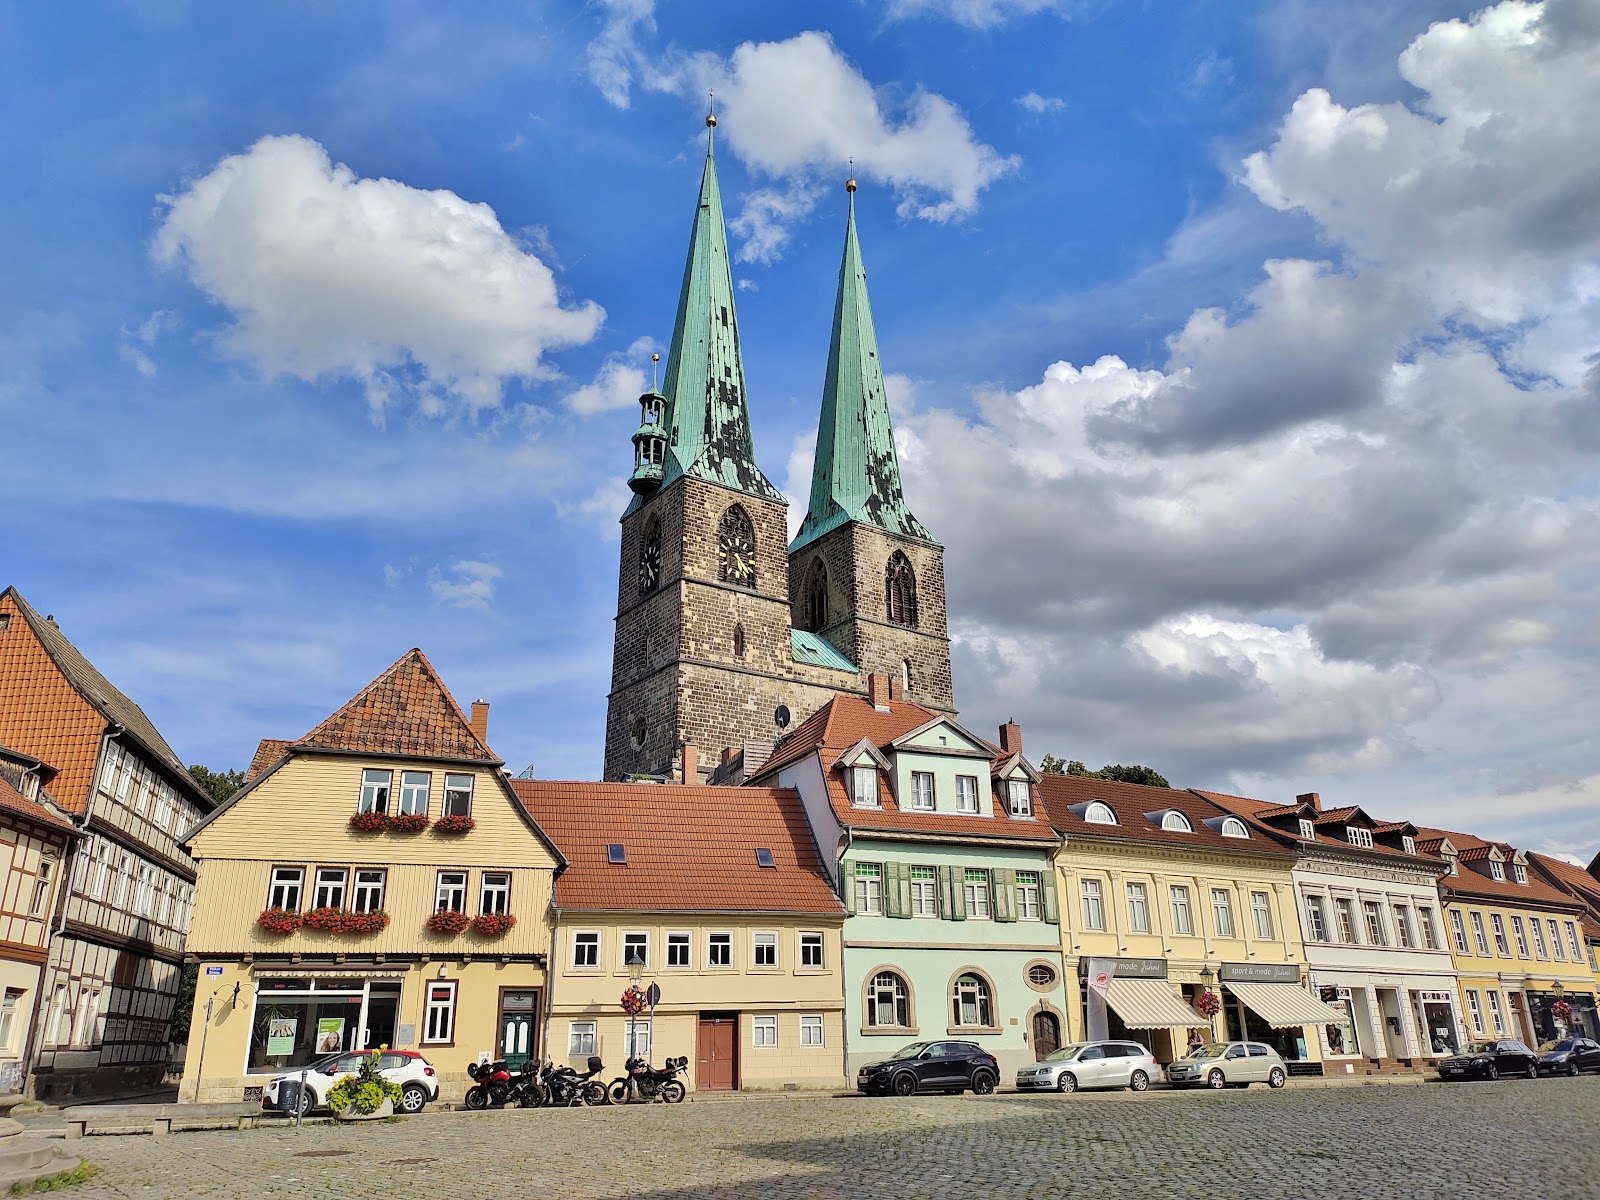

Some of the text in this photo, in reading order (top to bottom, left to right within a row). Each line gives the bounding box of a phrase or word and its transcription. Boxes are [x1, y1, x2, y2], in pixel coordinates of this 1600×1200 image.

[1119, 962, 1138, 970] mode
[1231, 967, 1248, 975] sport
[1248, 967, 1253, 975] &
